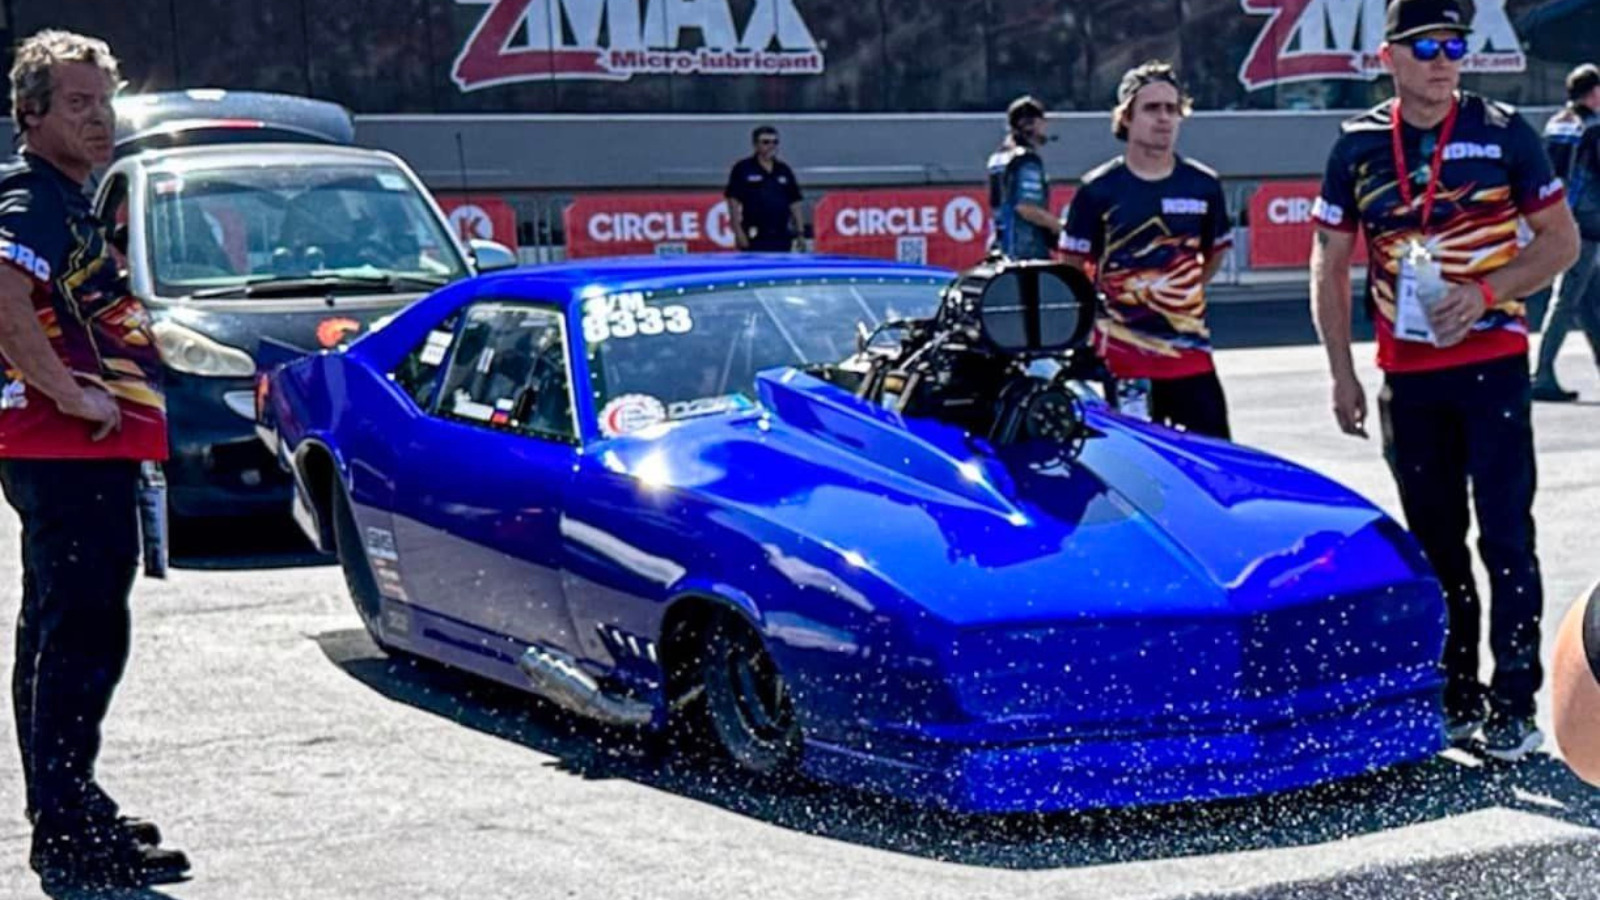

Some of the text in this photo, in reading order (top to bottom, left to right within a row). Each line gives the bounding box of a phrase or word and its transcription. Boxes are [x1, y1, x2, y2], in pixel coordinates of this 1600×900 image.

[835, 206, 938, 237] CIRCLE
[1267, 197, 1312, 223] CIR
[587, 211, 700, 242] CIRCLE
[582, 305, 693, 342] 8333
